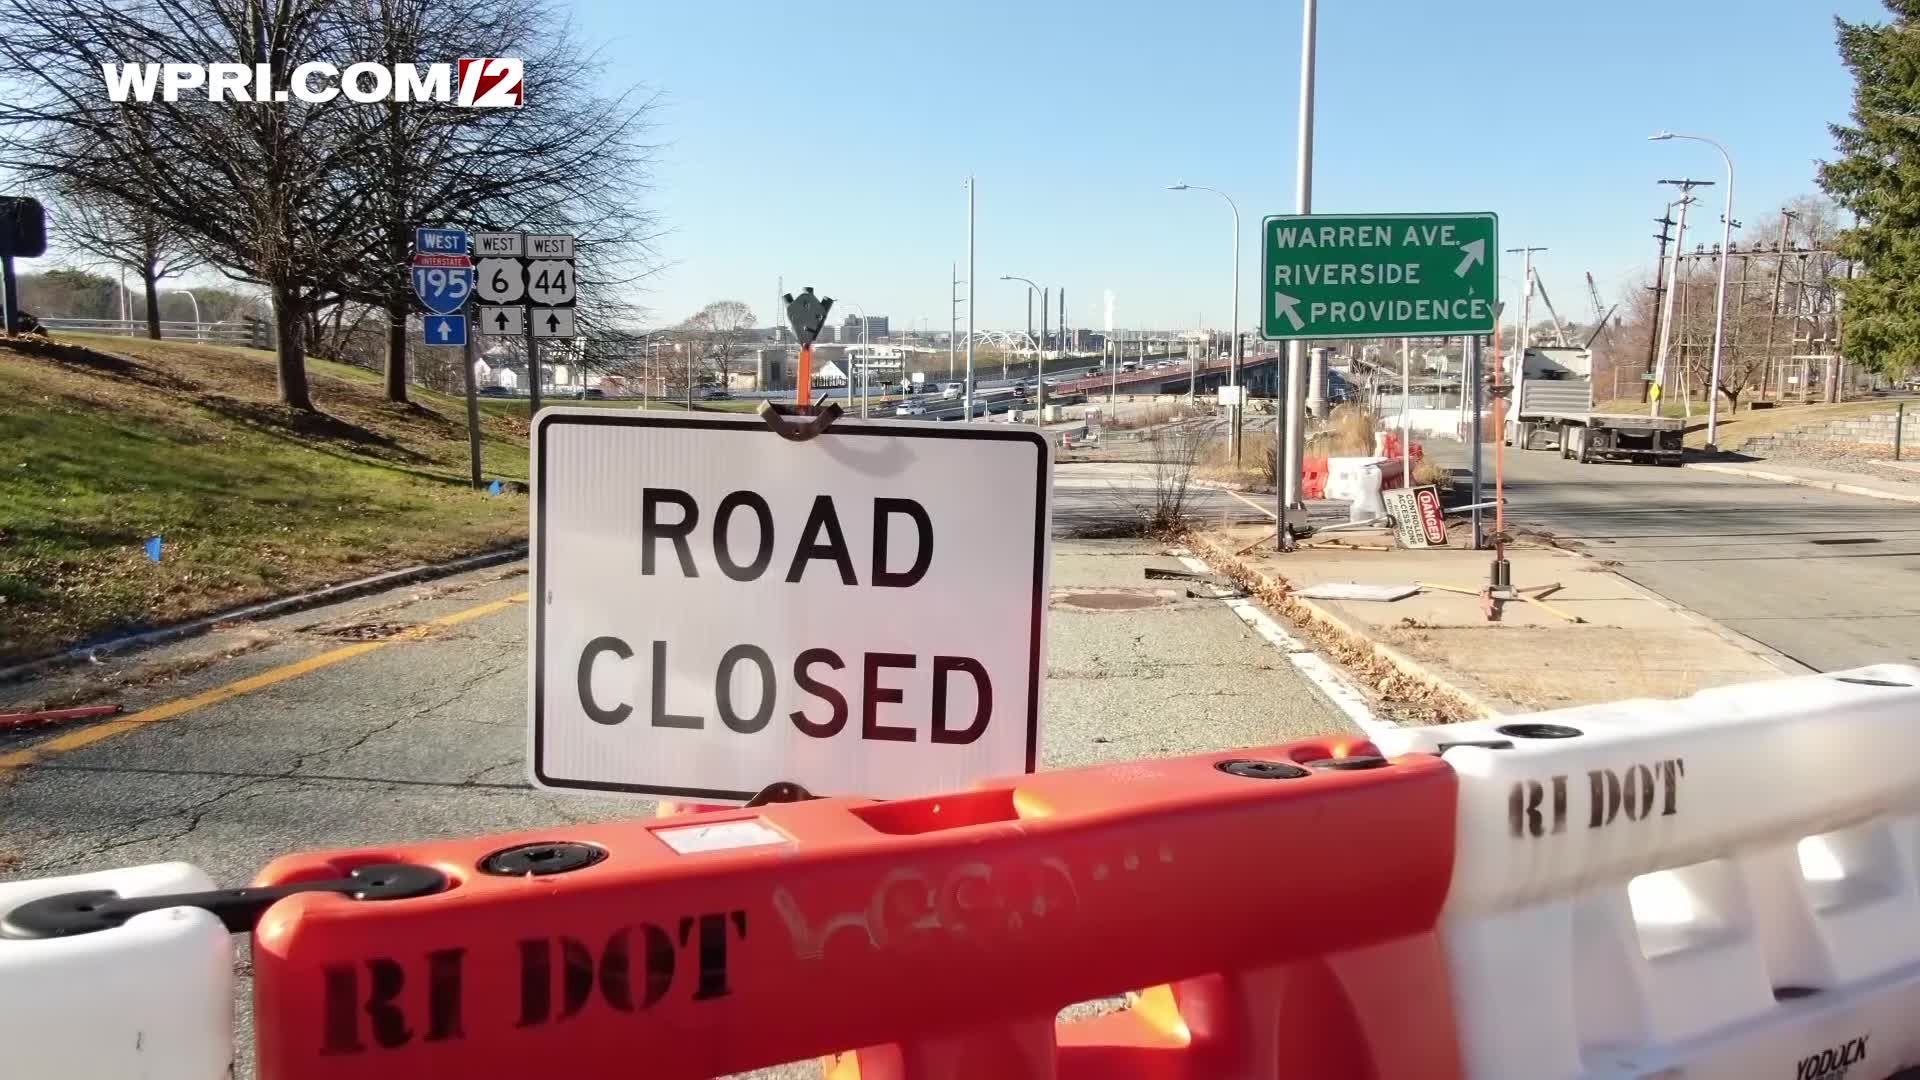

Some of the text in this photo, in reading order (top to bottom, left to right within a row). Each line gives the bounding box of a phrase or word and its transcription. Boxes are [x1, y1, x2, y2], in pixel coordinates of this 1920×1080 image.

[424, 233, 460, 249] WEST
[482, 237, 515, 251] WEST
[534, 239, 566, 253] WEST
[1276, 225, 1460, 248] WARREN AVE.
[421, 258, 462, 266] INTERSTATE
[1274, 263, 1421, 286] RIVERSIDE
[417, 269, 468, 298] 195
[492, 268, 509, 294] 6
[534, 269, 567, 295] 44
[1310, 299, 1486, 323] PROVIDENCE
[1398, 494, 1418, 545] ACCESS ZONE
[1405, 494, 1424, 544] CONTROLLED
[1420, 495, 1441, 541] DANGER
[641, 487, 934, 588] ROAD
[577, 636, 993, 745] CLOSED
[1508, 758, 1685, 838] RI DOT
[318, 910, 747, 1056] RI DOT
[1797, 1034, 1870, 1080] YODUCK
